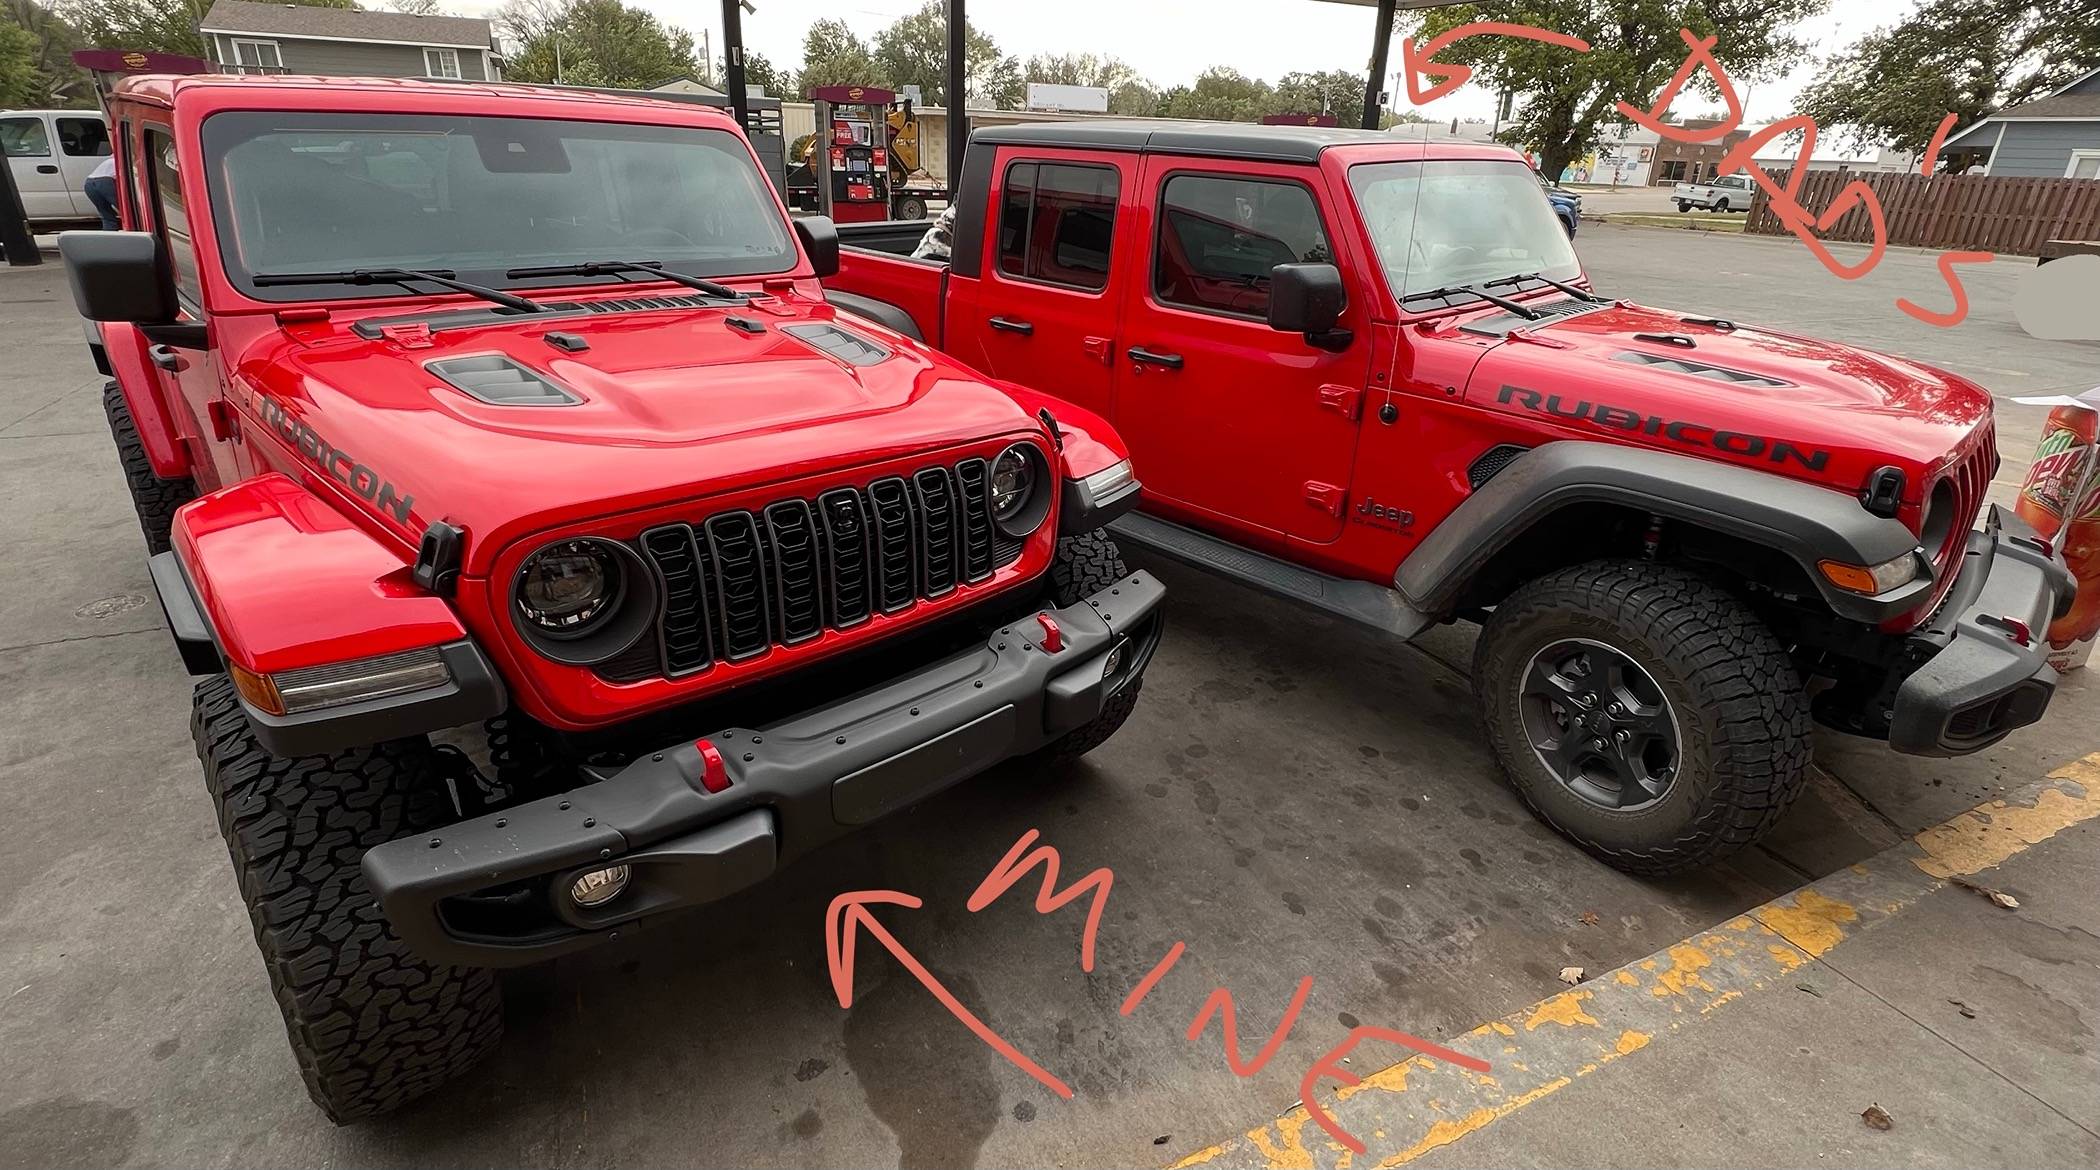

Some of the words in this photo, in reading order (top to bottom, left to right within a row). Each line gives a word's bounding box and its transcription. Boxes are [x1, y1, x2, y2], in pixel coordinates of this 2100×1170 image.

[262, 393, 416, 525] RUBICON
[1497, 384, 1831, 473] RUBICON
[1356, 496, 1413, 529] Jeep
